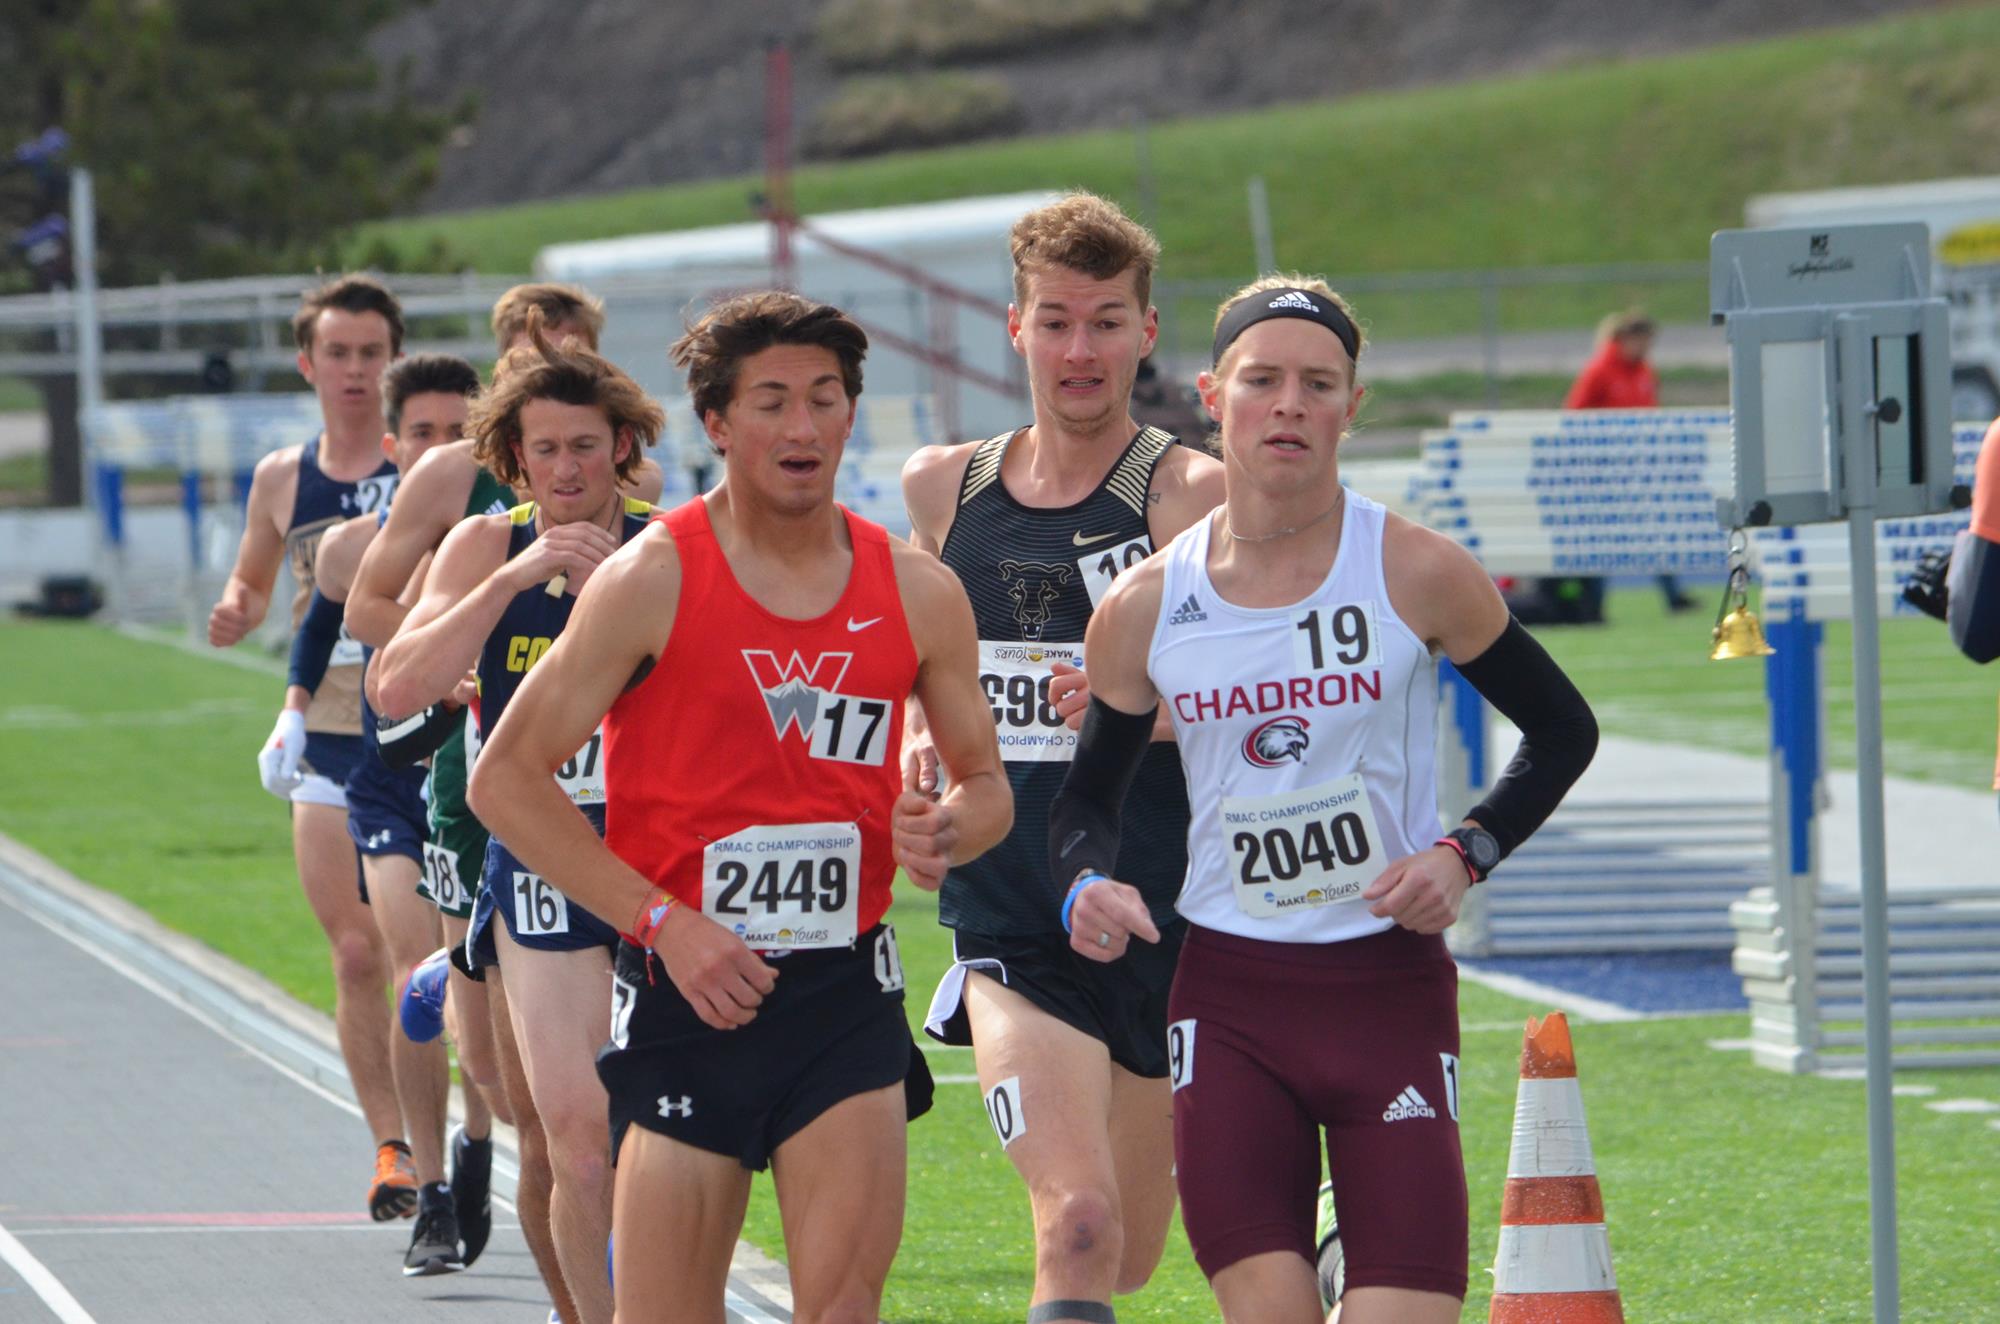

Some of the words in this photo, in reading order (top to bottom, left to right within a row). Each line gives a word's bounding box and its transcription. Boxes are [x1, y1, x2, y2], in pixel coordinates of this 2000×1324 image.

[1268, 298, 1320, 313] adidas
[1169, 612, 1208, 626] adidas
[1044, 650, 1073, 658] MAKE
[1297, 605, 1369, 670] 19
[1174, 670, 1381, 724] CHADRON
[824, 698, 886, 761] 17
[1225, 812, 1258, 824] RMAC
[1260, 789, 1360, 822] CHAMPIONSHIP
[714, 842, 753, 853] RMAC
[756, 837, 855, 852] CHAMPIONSHIP
[1233, 811, 1370, 885] 2040
[427, 848, 454, 903] 18
[715, 857, 848, 915] 2449
[517, 876, 557, 931] 16
[1276, 895, 1307, 908] MAKE
[744, 932, 776, 943] MAKE
[1382, 1105, 1436, 1123] adidas
